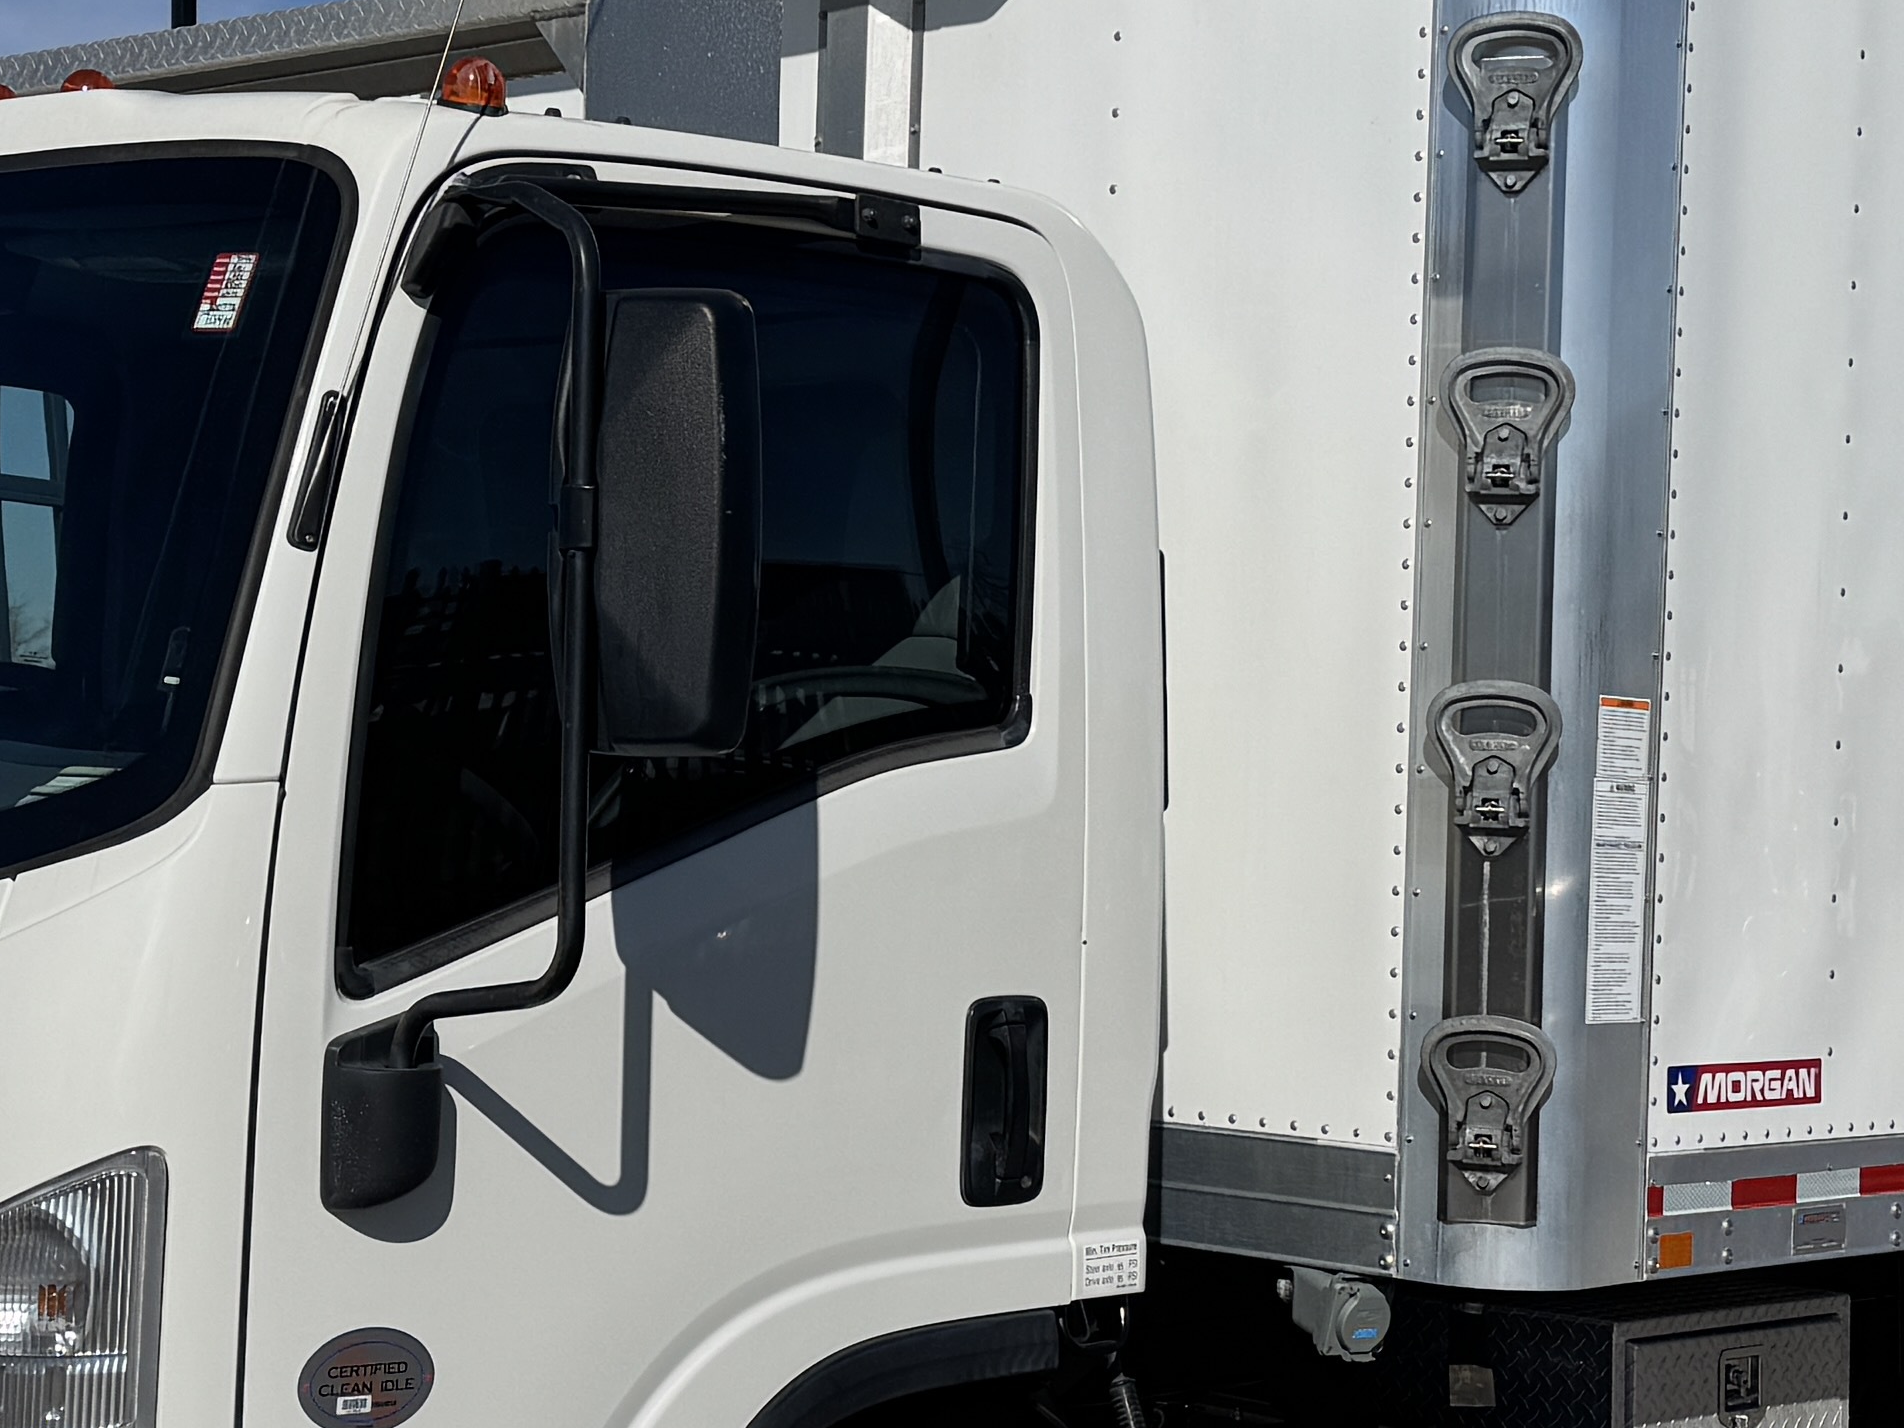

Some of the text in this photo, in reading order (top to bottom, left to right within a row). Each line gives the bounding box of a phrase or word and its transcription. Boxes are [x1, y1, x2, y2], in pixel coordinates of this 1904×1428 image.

[1696, 1067, 1816, 1105] MORGAN
[327, 1360, 408, 1379] CERTIFIED
[318, 1377, 415, 1397] CLEAN IDLE
